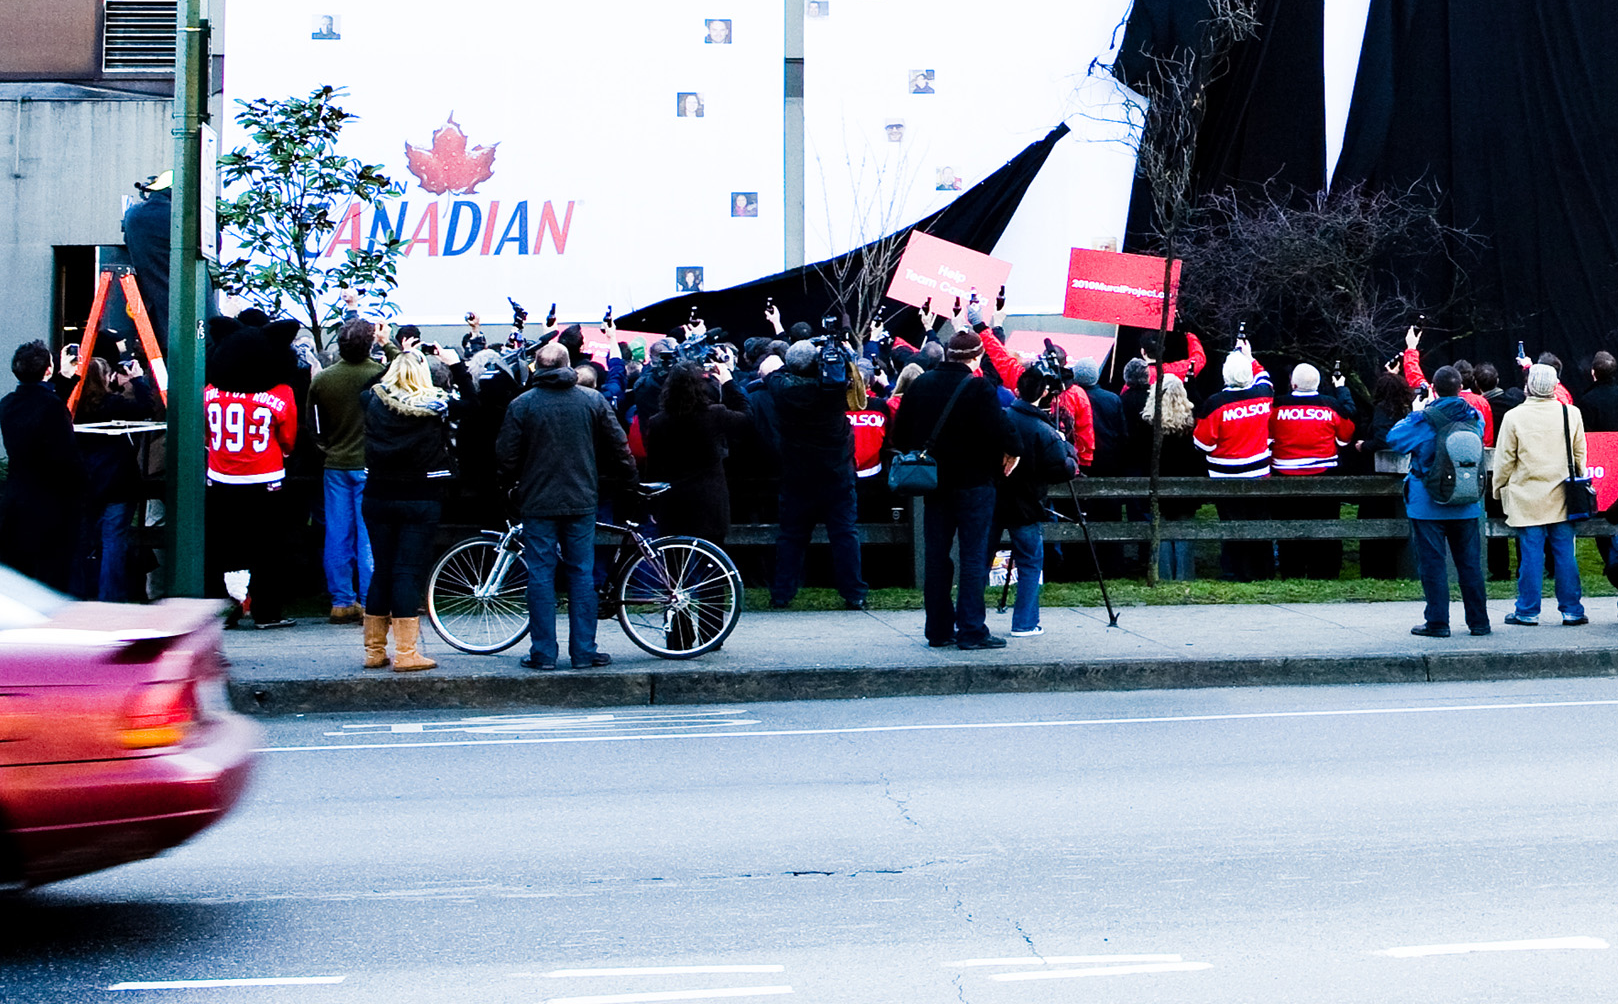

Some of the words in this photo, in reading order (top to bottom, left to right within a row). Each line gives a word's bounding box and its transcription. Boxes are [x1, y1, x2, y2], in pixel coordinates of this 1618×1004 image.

[905, 268, 938, 289] Team
[938, 264, 967, 284] Help
[1277, 408, 1333, 422] MOLSON
